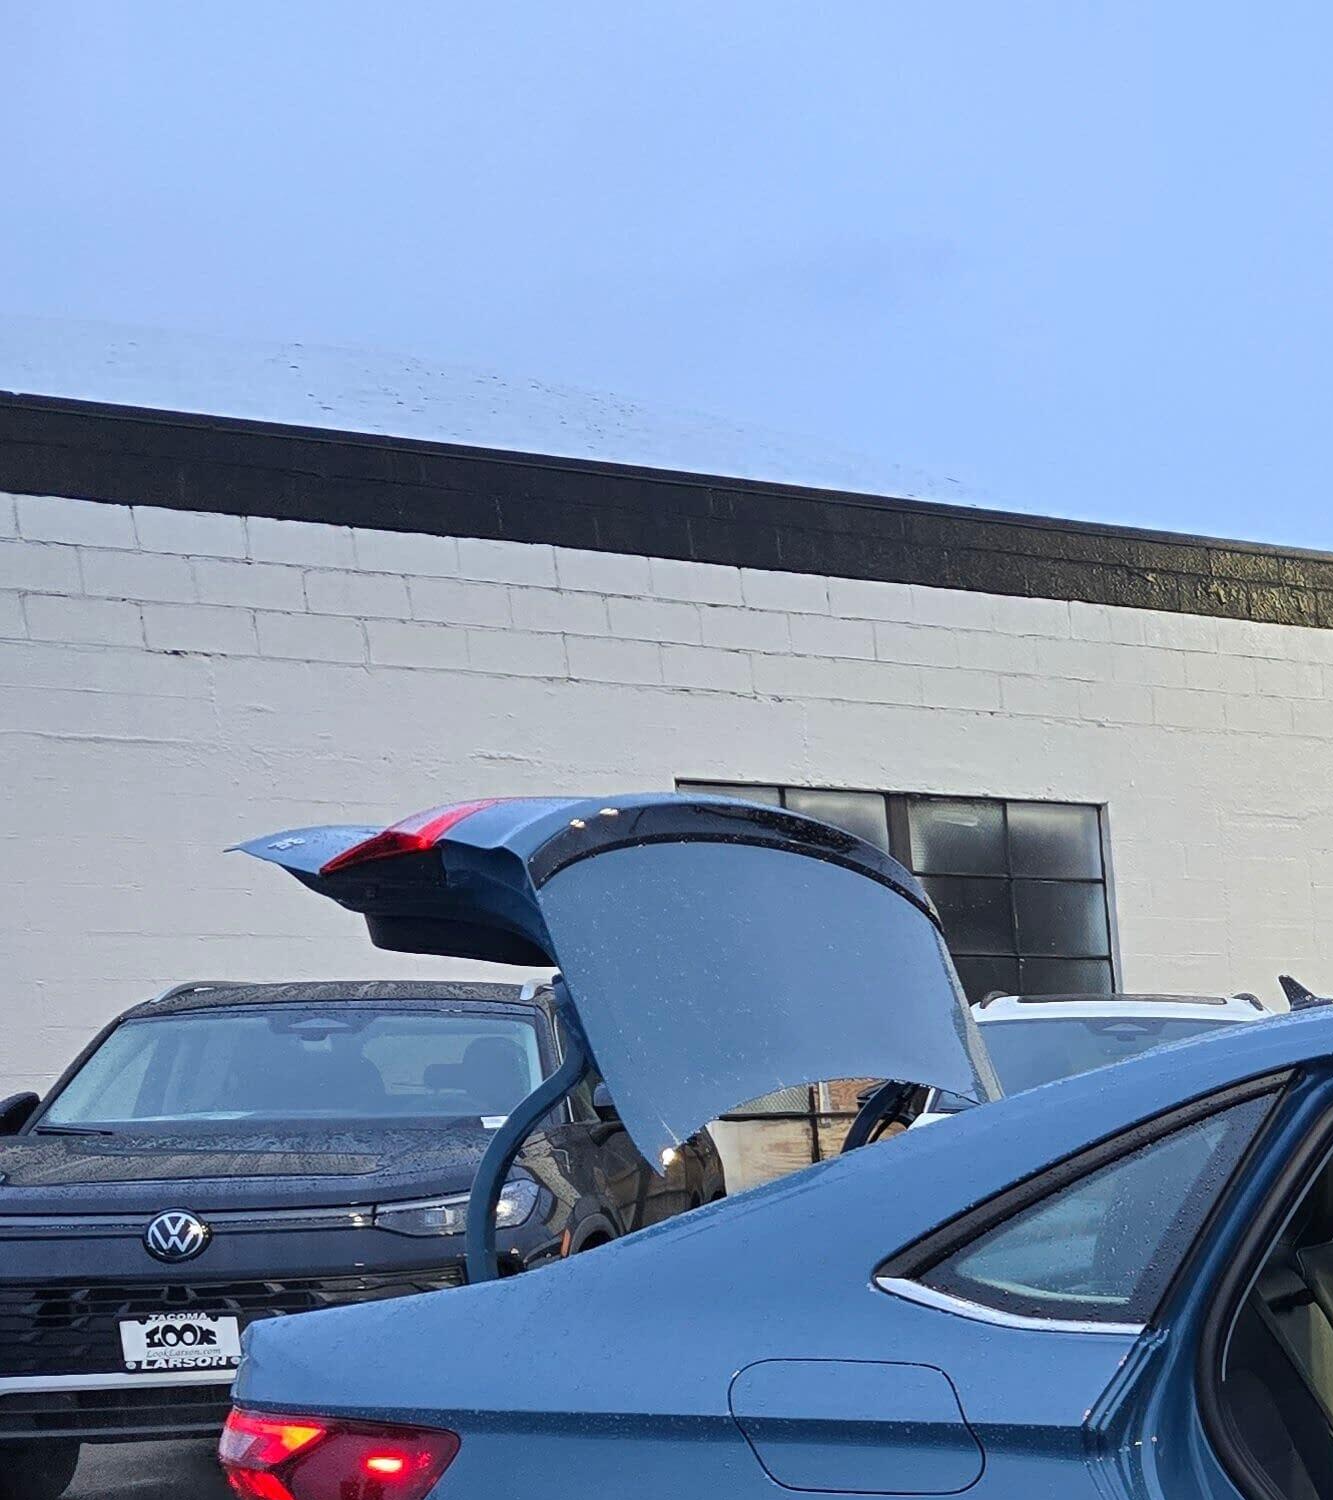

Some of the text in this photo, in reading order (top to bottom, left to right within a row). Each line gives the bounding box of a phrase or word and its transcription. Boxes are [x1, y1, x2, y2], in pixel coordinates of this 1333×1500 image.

[148, 1312, 209, 1322] TACOMA
[145, 1323, 217, 1348] LOOK
[141, 1355, 227, 1370] LARSON
